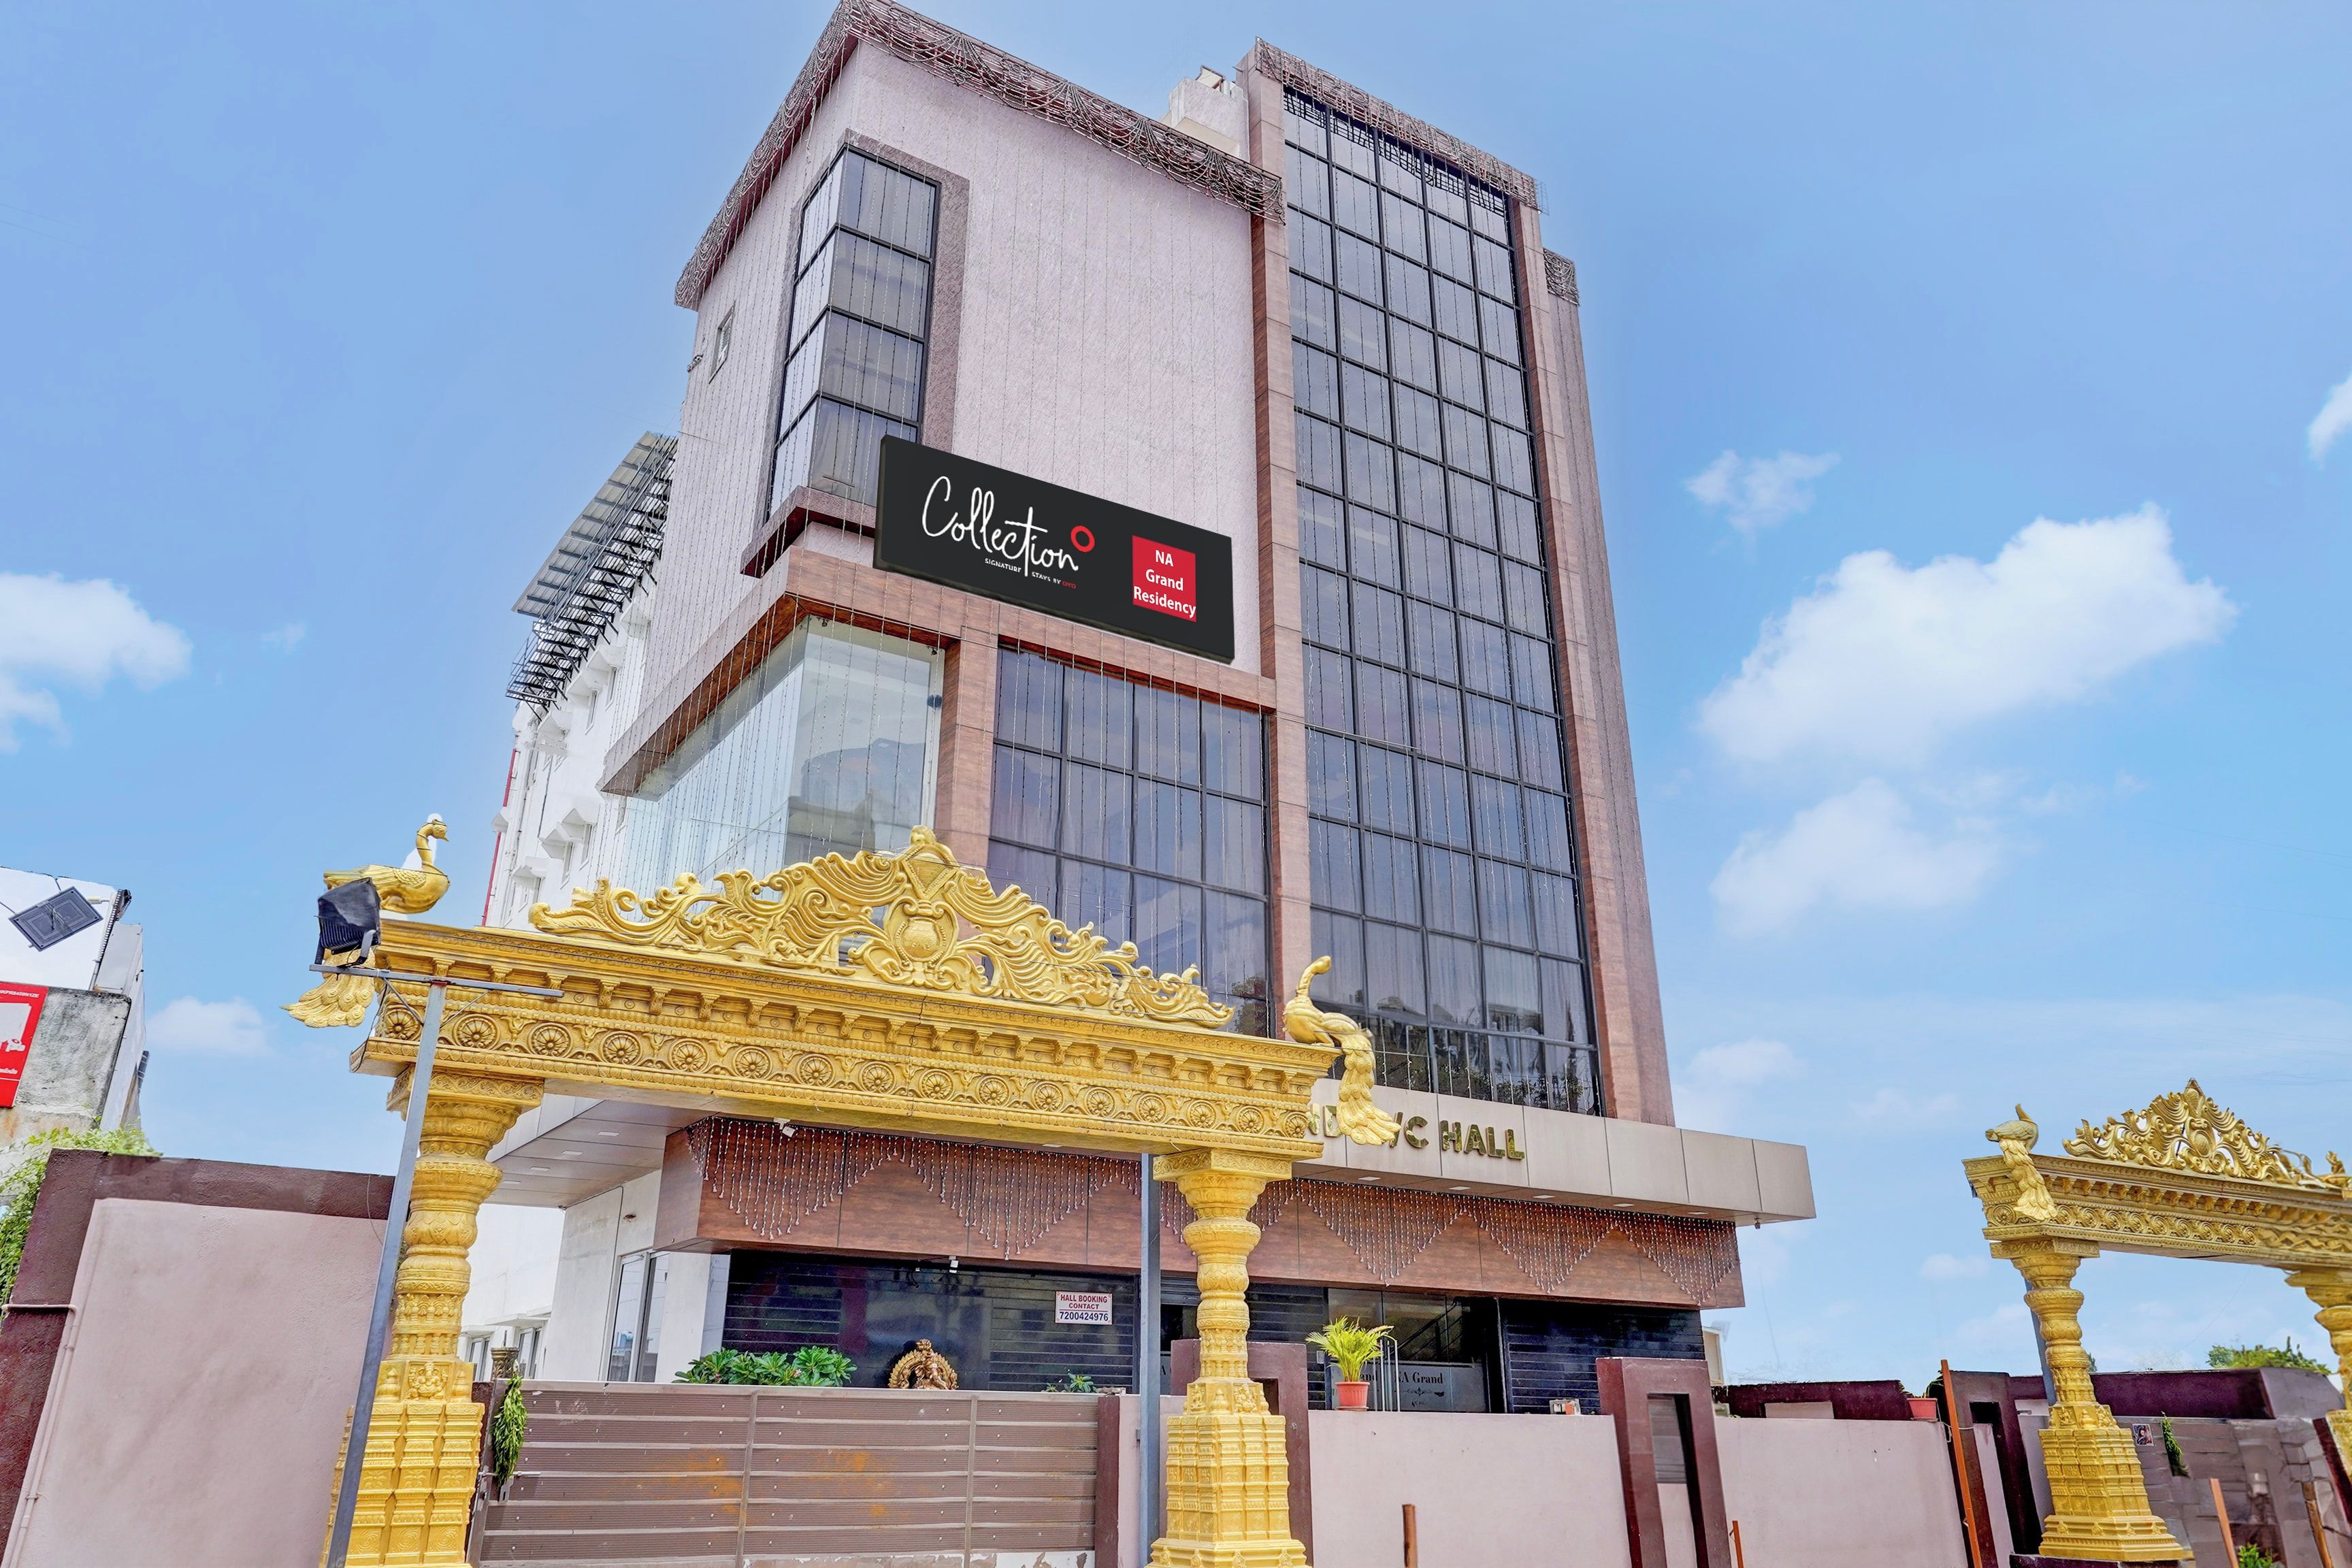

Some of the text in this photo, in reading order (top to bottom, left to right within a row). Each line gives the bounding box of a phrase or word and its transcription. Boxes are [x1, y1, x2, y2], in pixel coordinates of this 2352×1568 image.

[922, 476, 1079, 577] Collection
[1155, 549, 1174, 567] NA
[984, 557, 1022, 573] SIGNATURE
[1031, 571, 1051, 583] STAYS
[1145, 568, 1183, 591] Grand
[1133, 585, 1196, 618] Residency
[1440, 1120, 1525, 1160] HALL
[1060, 1294, 1107, 1303] HALL BOOKING
[1059, 1311, 1109, 1322] 7200424976
[1412, 1371, 1443, 1384] Grand
